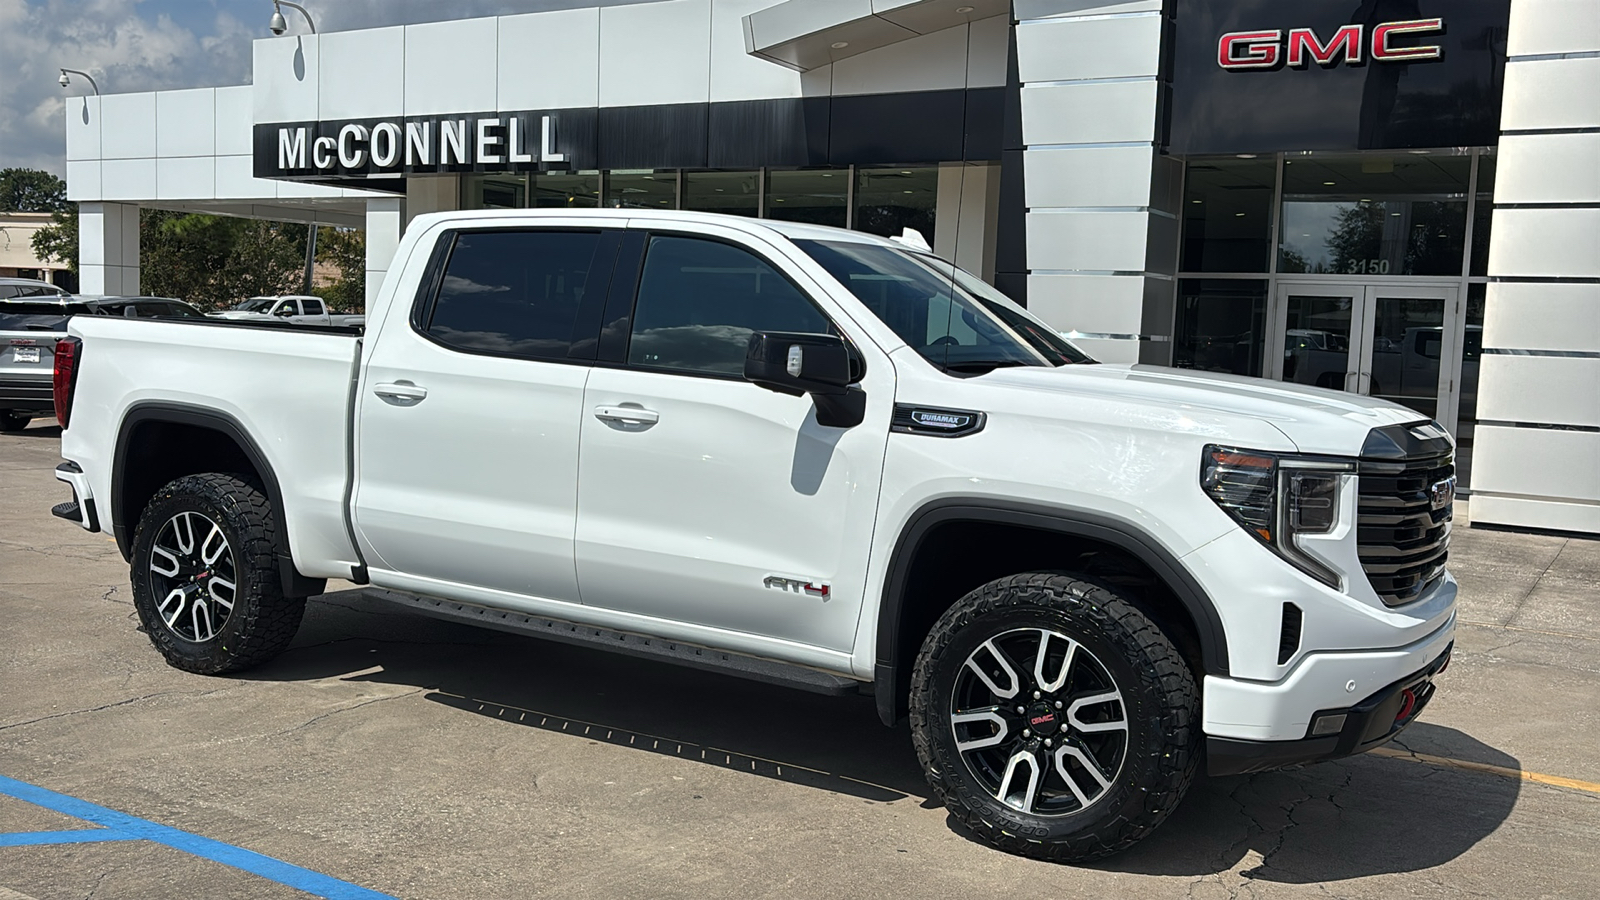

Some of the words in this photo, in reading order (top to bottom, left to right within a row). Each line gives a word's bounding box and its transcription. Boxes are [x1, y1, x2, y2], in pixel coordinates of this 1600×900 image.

[1217, 17, 1443, 69] GMC
[278, 115, 567, 169] McCONNELL
[1347, 258, 1390, 275] 3150
[920, 413, 960, 424] DURAMAX
[763, 575, 831, 603] AT4
[1031, 713, 1055, 725] GMC
